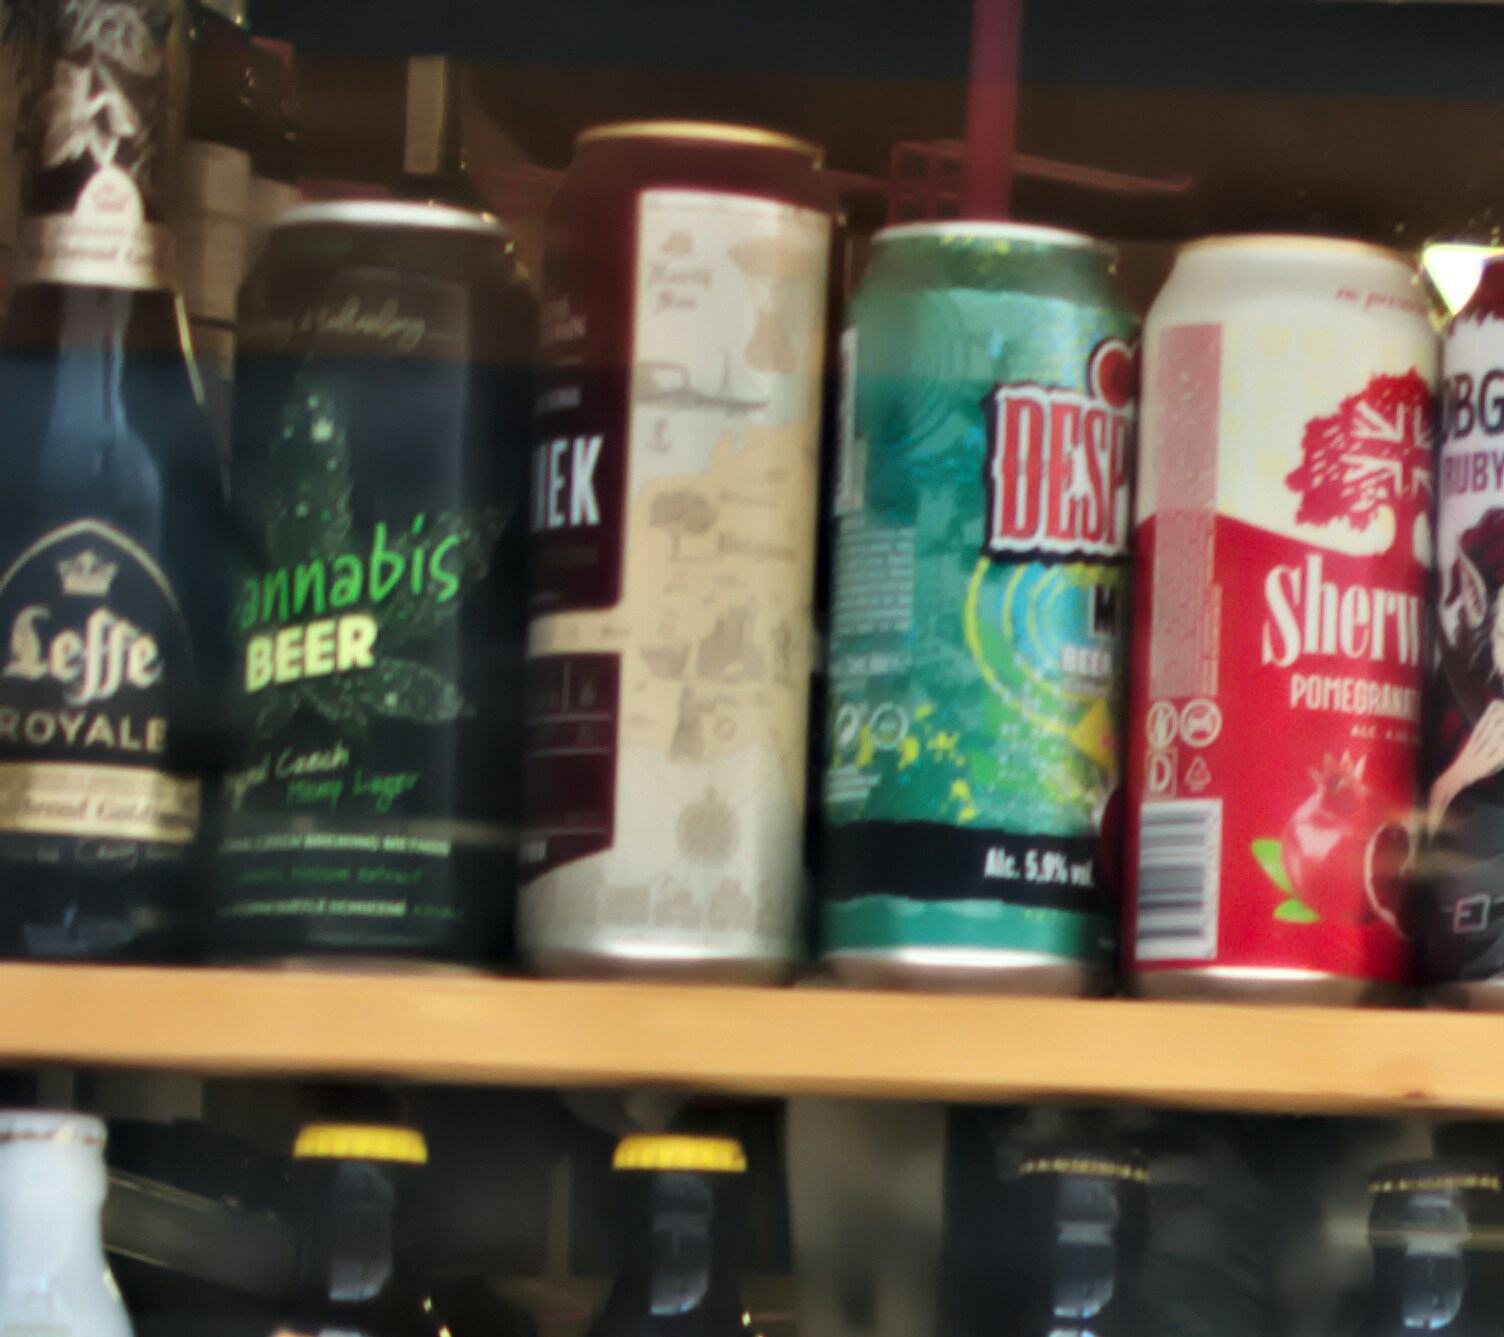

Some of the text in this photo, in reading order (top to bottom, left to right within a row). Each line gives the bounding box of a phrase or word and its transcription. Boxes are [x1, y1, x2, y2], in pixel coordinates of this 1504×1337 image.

[240, 515, 462, 628] annabis
[4, 605, 164, 708] Leffe
[246, 616, 377, 693] BEER
[0, 710, 168, 754] ROYALE
